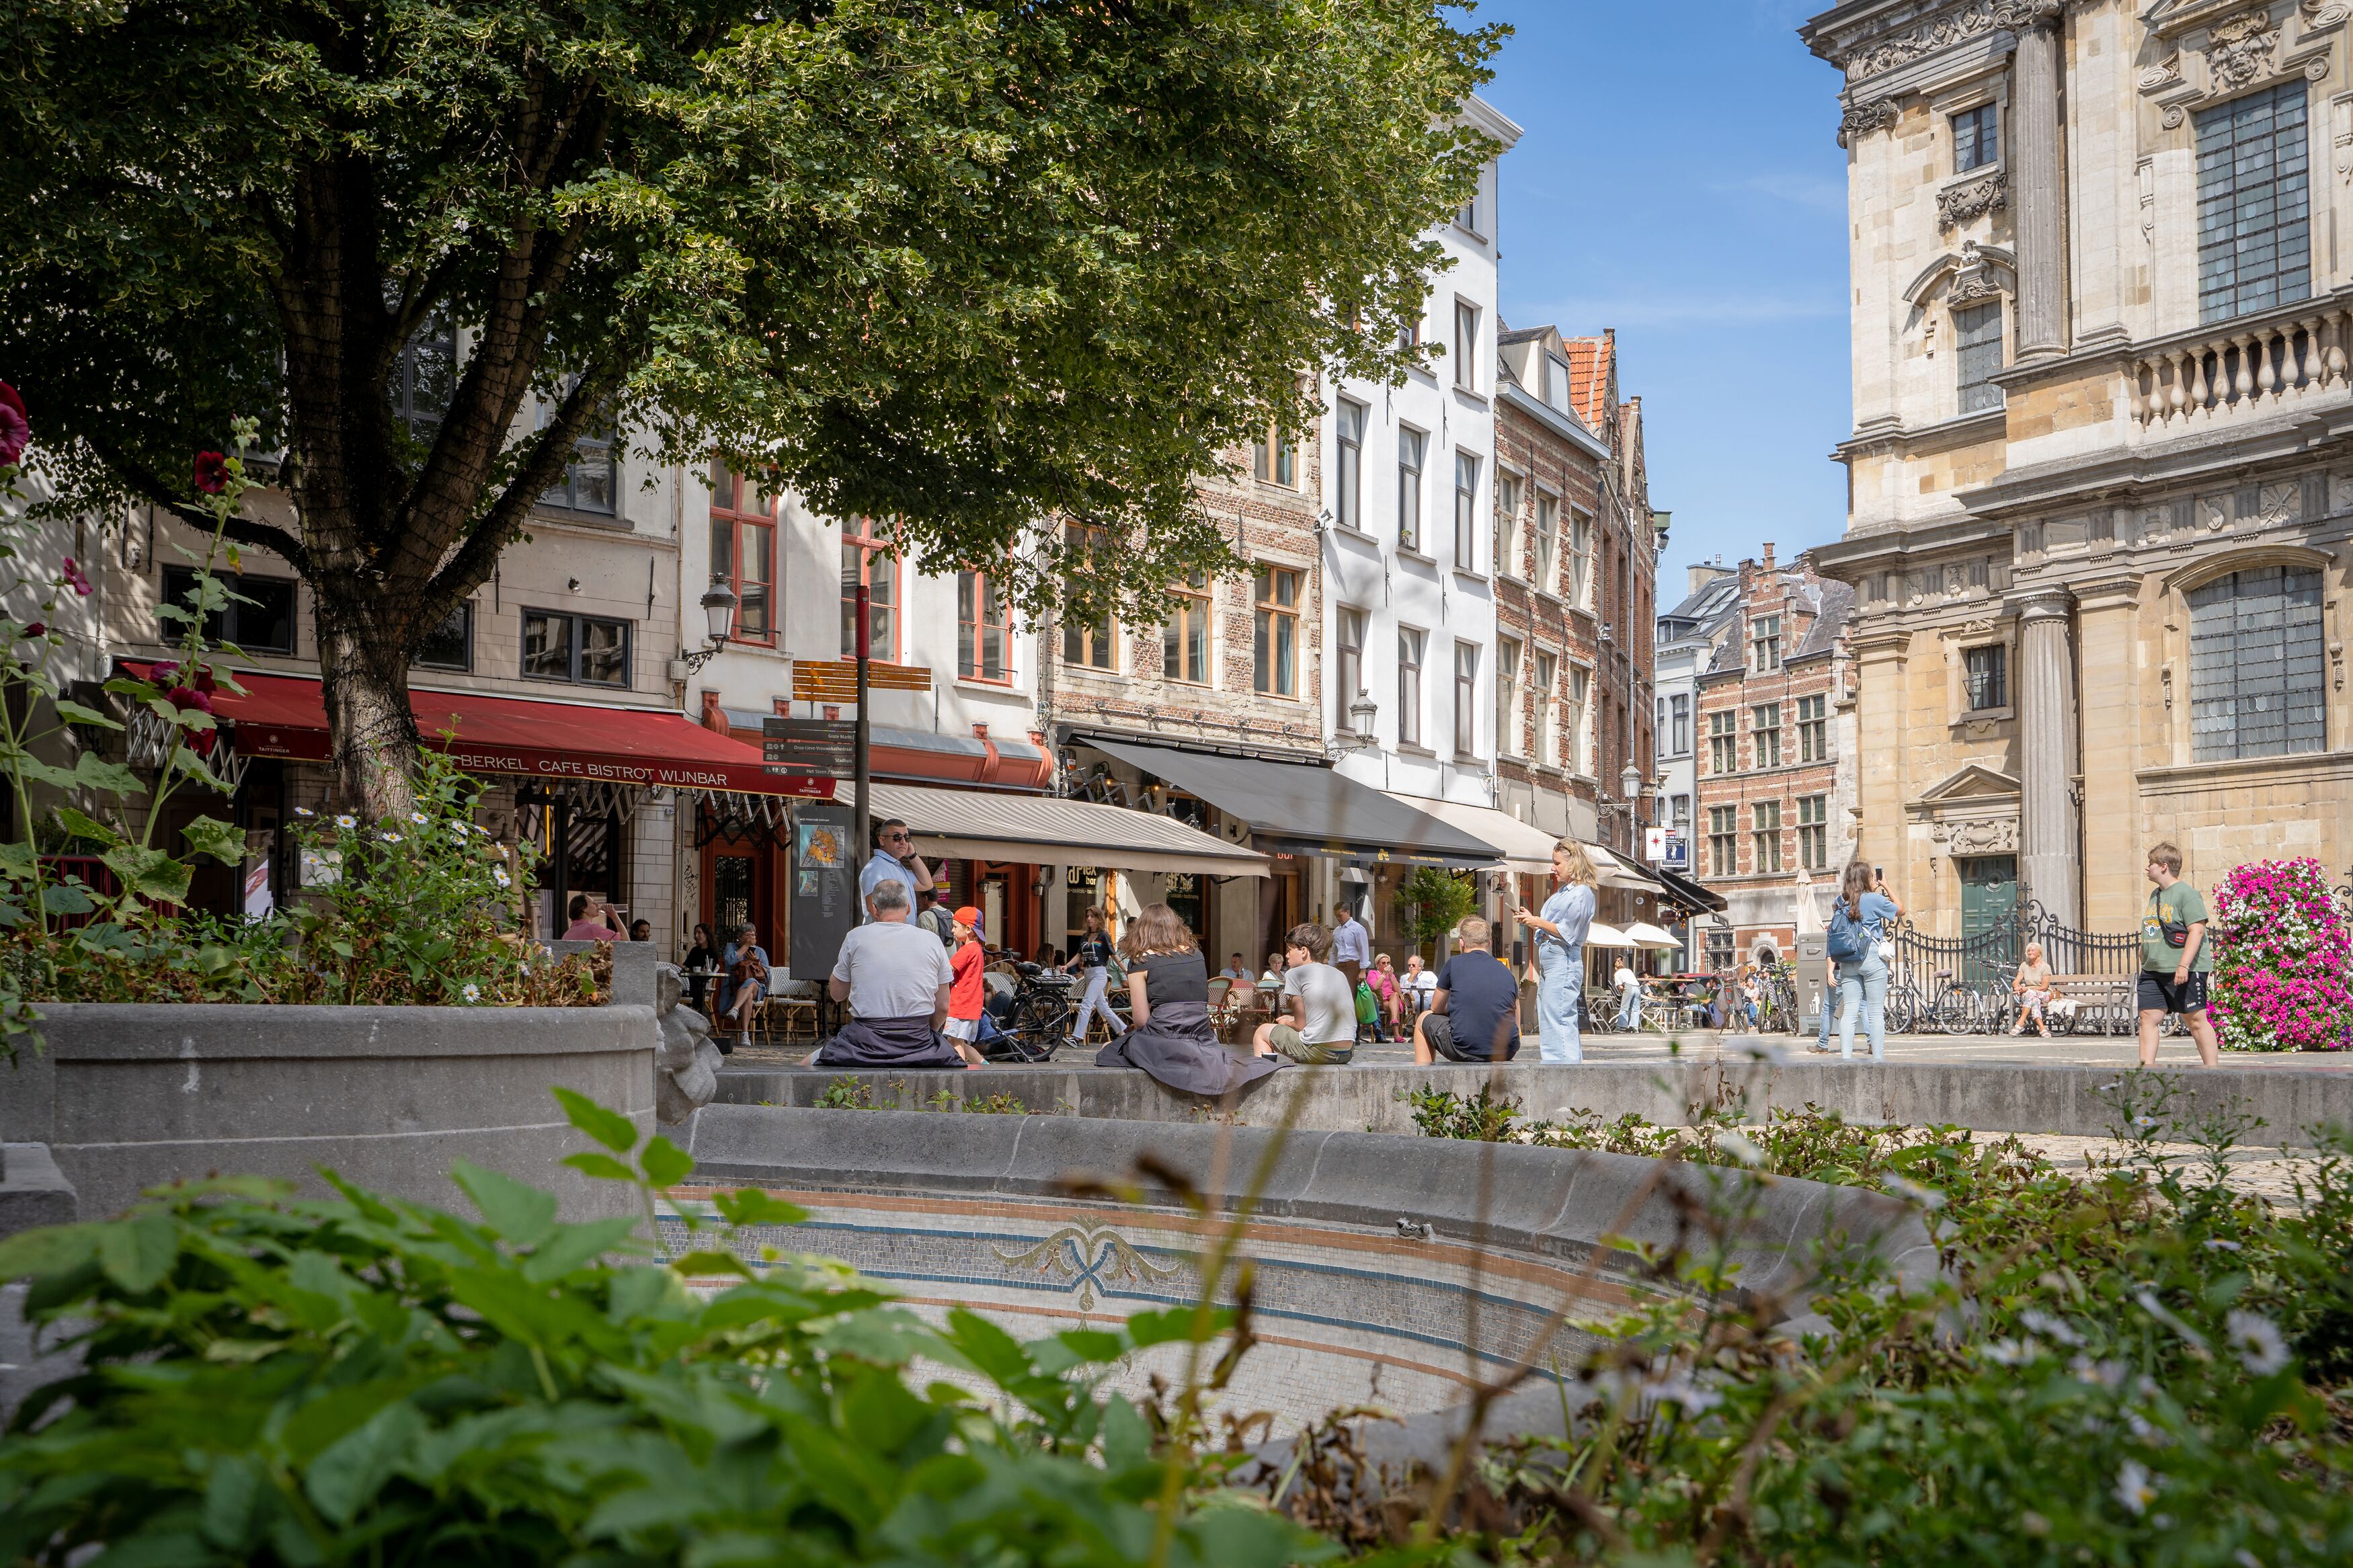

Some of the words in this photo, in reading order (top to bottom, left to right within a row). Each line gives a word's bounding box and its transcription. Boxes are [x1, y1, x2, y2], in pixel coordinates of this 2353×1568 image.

[461, 755, 529, 770] BERKEL
[539, 760, 583, 774] CAFE
[587, 764, 654, 780] BISTROT
[659, 769, 727, 786] WIJNBAR
[1086, 876, 1096, 885] bar
